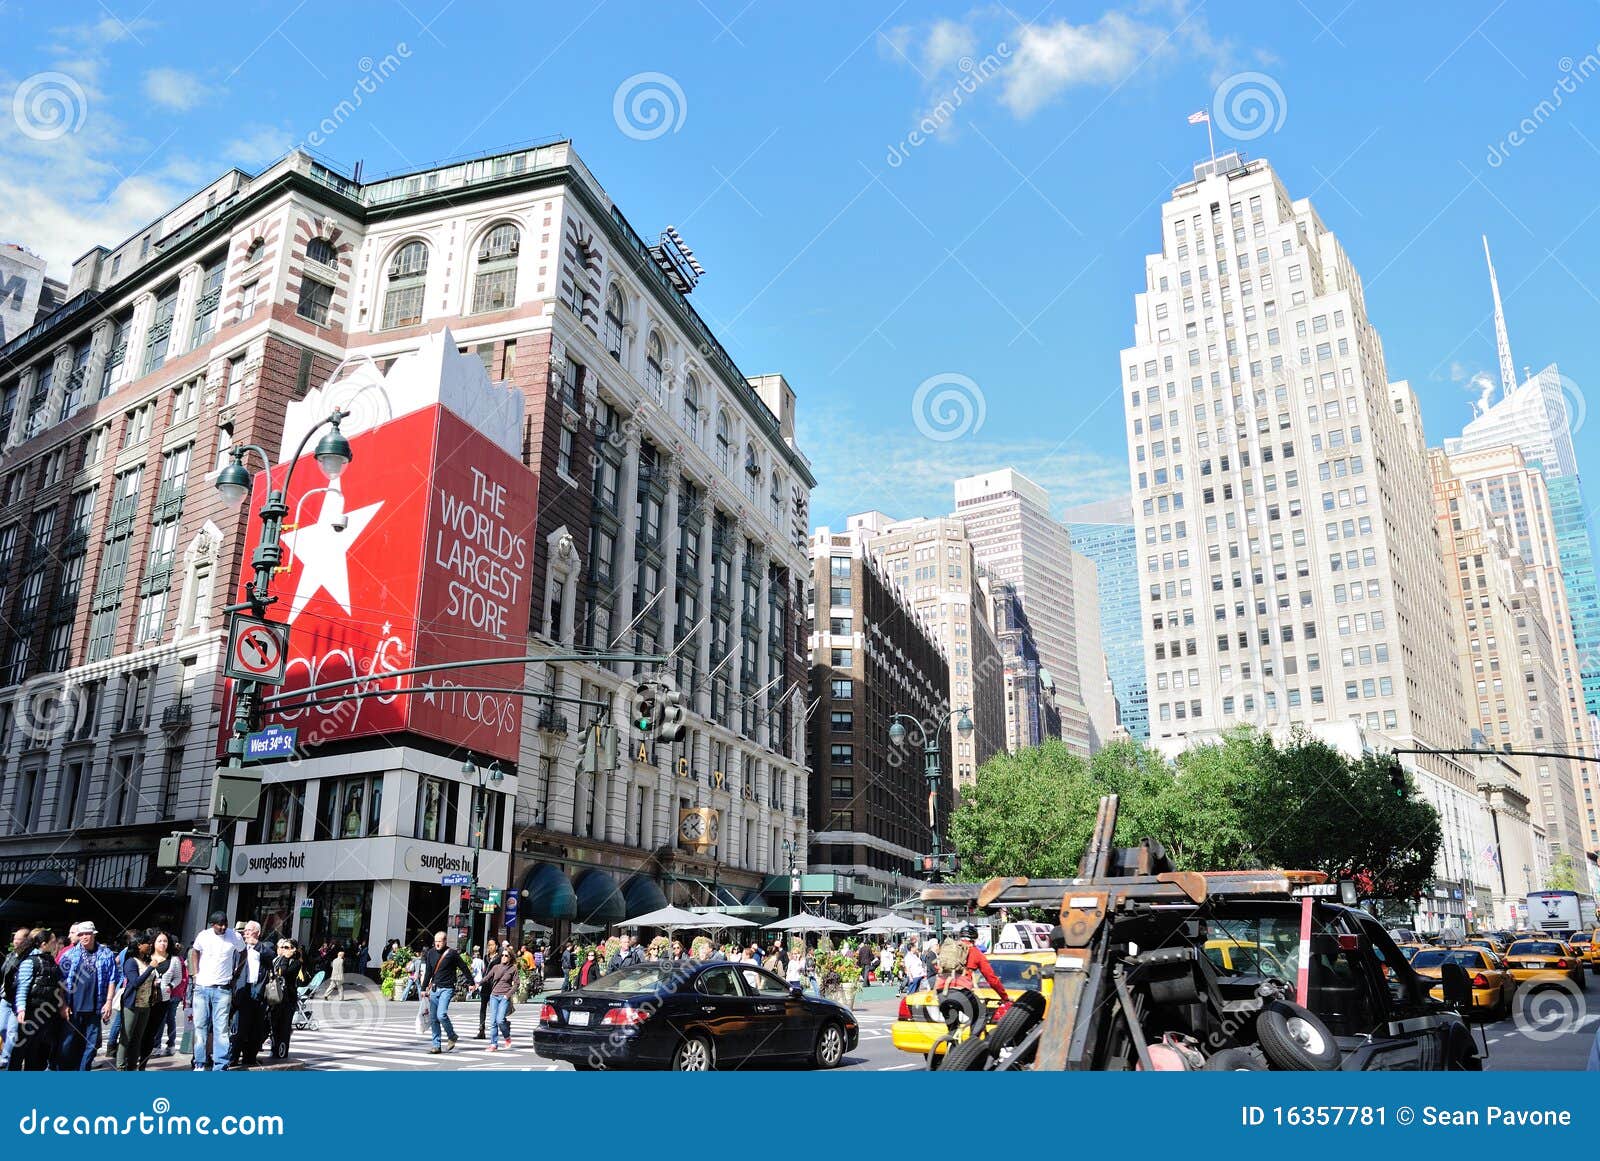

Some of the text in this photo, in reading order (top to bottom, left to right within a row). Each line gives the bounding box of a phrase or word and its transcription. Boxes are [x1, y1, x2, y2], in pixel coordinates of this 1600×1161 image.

[470, 466, 507, 520] THE
[441, 488, 527, 570] WORLD'S
[435, 530, 522, 605] LARGEST
[446, 580, 509, 641] STORE
[251, 738, 269, 752] West
[284, 735, 292, 749] St
[249, 851, 305, 874] sunglass hut
[420, 852, 472, 874] sunglass hu
[1292, 884, 1337, 896] RAFFIC
